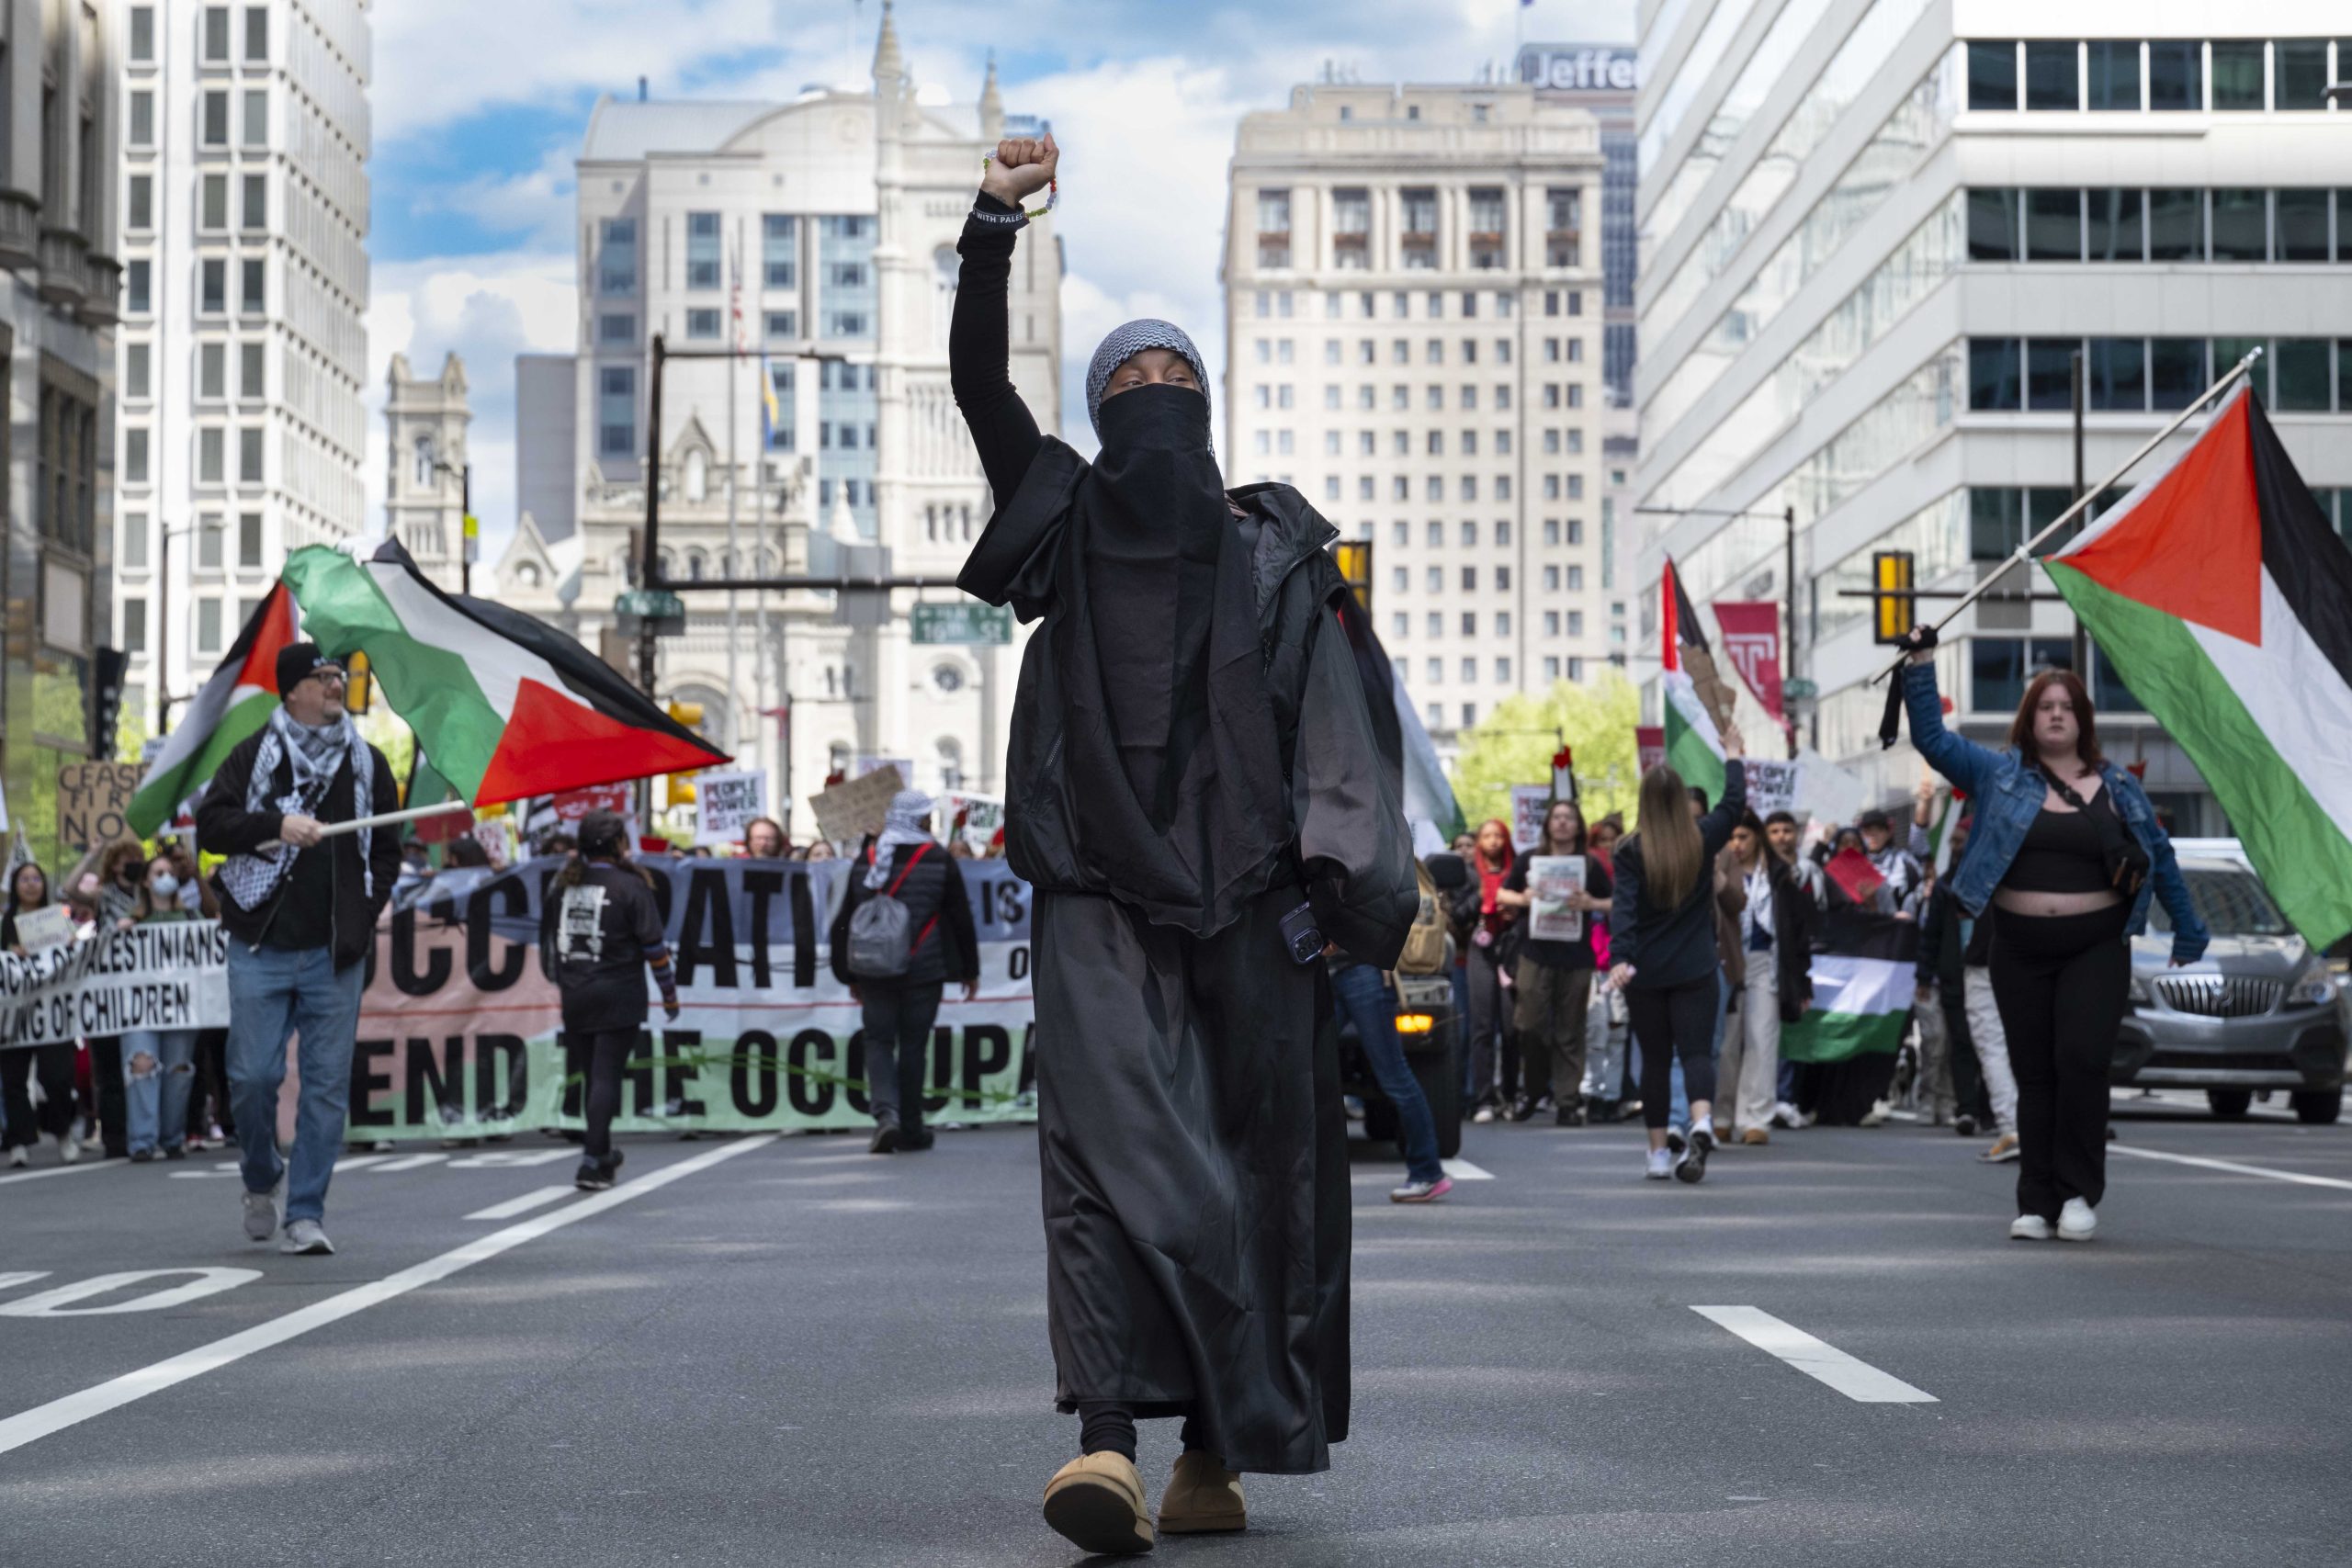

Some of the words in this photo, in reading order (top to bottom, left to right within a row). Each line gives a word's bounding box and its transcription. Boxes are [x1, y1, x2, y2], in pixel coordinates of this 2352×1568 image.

[977, 211, 997, 223] WITH
[1000, 212, 1024, 223] PALES
[704, 777, 757, 796] PEOPLE
[70, 788, 124, 809] FIR
[705, 794, 759, 813] POWER
[981, 881, 1023, 925] IS
[51, 993, 74, 1038] OF
[81, 982, 189, 1032] CHILDREN
[349, 1035, 528, 1127] END
